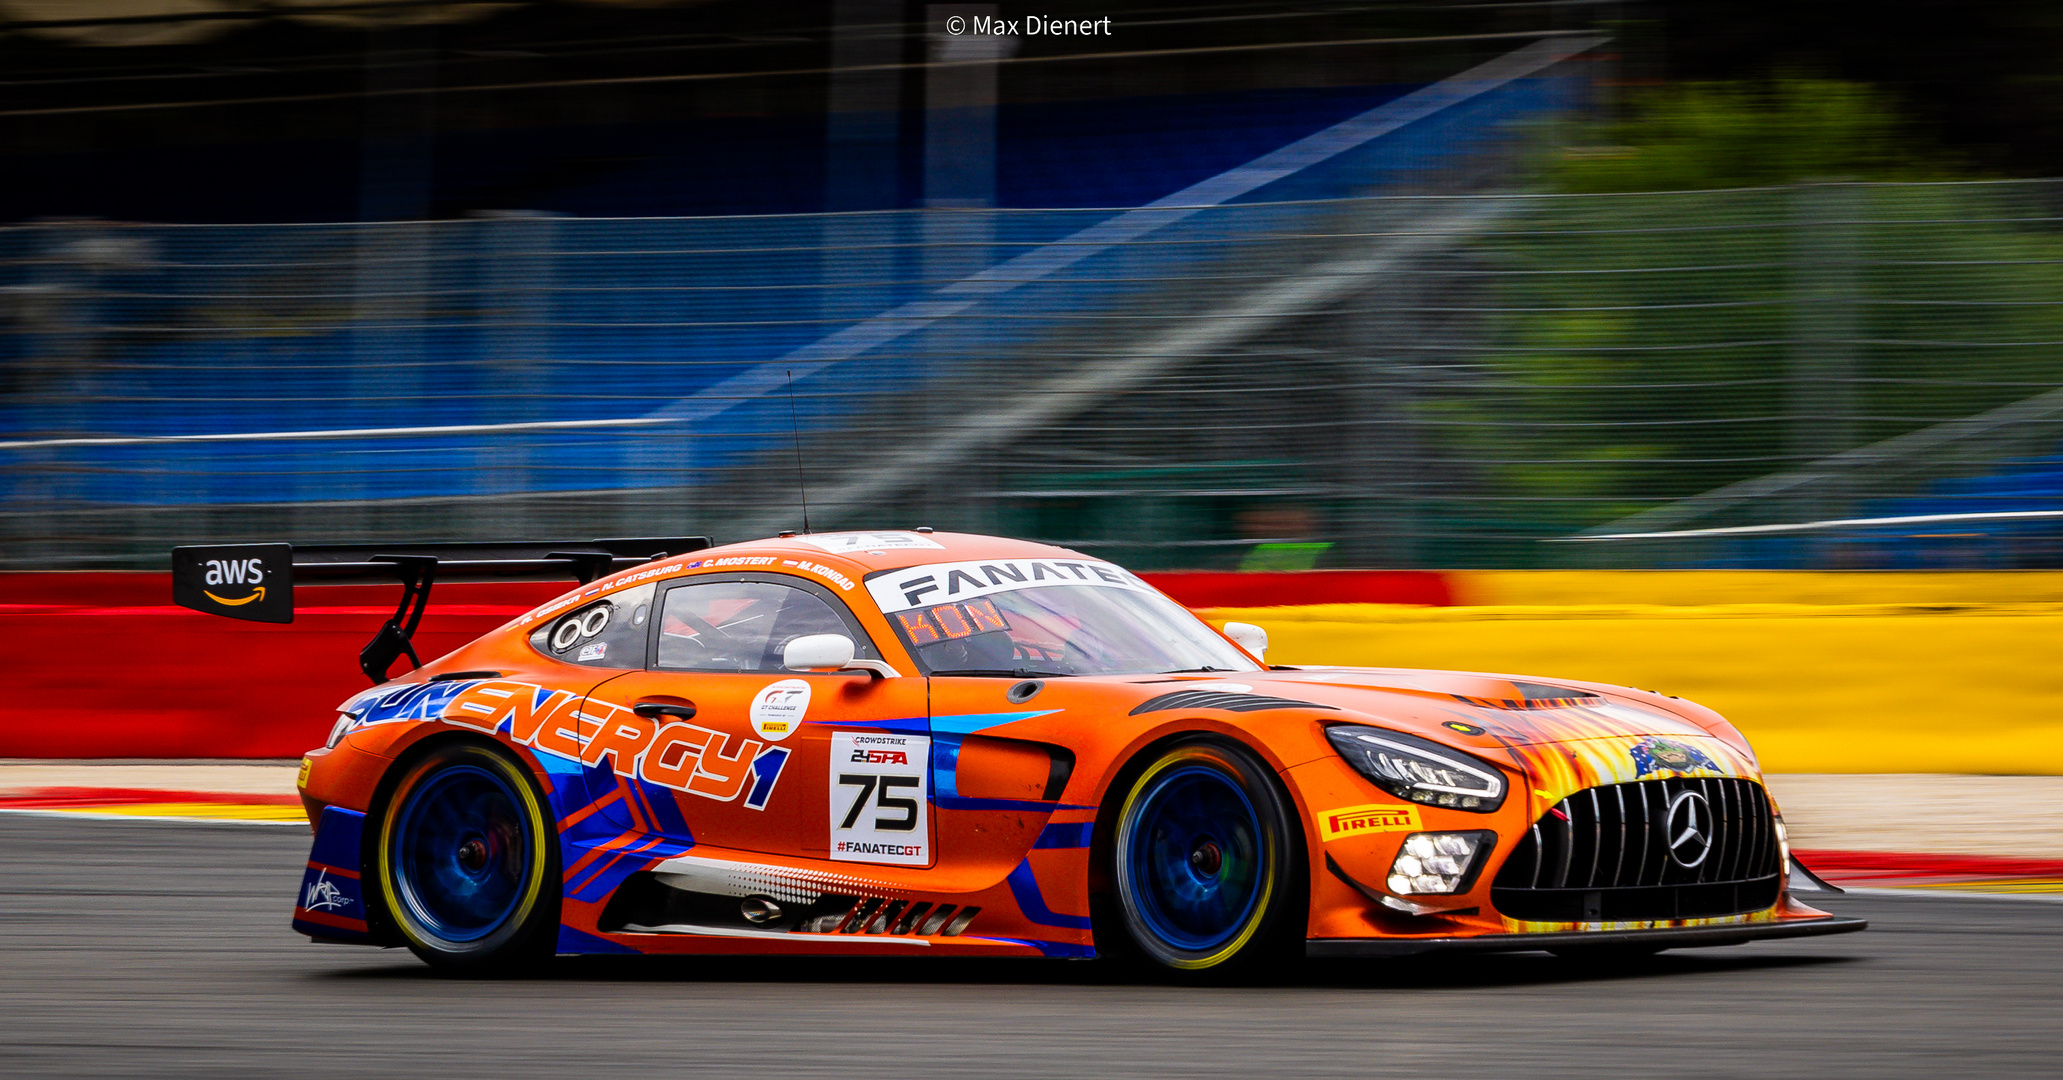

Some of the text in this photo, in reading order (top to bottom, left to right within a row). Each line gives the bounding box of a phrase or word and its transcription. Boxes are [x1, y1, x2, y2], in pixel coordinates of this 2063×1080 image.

[205, 558, 264, 586] aws
[702, 556, 778, 568] C. MOSTERT
[615, 563, 683, 587] CATSBURG
[898, 600, 1005, 645] KON
[763, 723, 787, 731] PIRELLI
[346, 678, 793, 812] SUNENERGY1
[854, 736, 907, 746] CROWDSTRIKE
[837, 772, 921, 833] 75
[1328, 809, 1412, 834] PIRELLI
[837, 841, 922, 857] #FANATECGT
